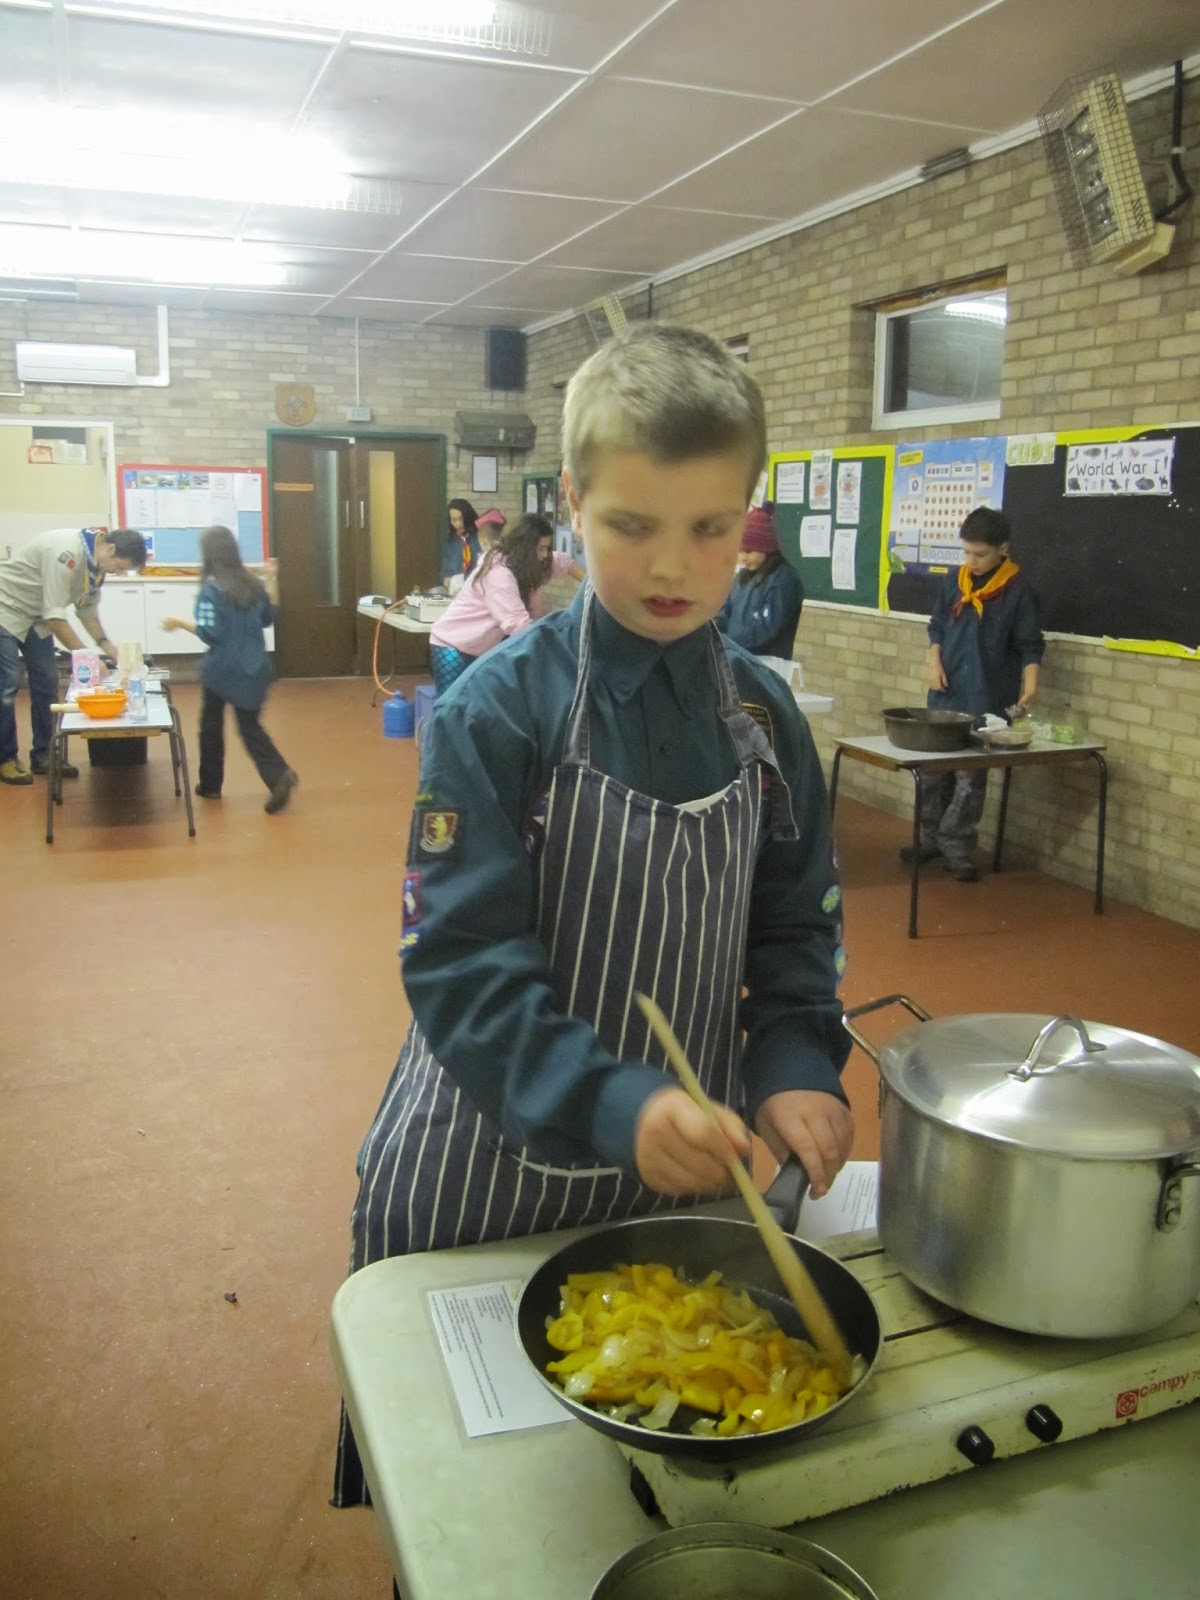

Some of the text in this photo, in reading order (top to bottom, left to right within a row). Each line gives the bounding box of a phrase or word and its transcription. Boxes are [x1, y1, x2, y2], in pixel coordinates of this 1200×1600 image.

[1076, 459, 1160, 476] World War I
[1139, 1372, 1189, 1398] campy
